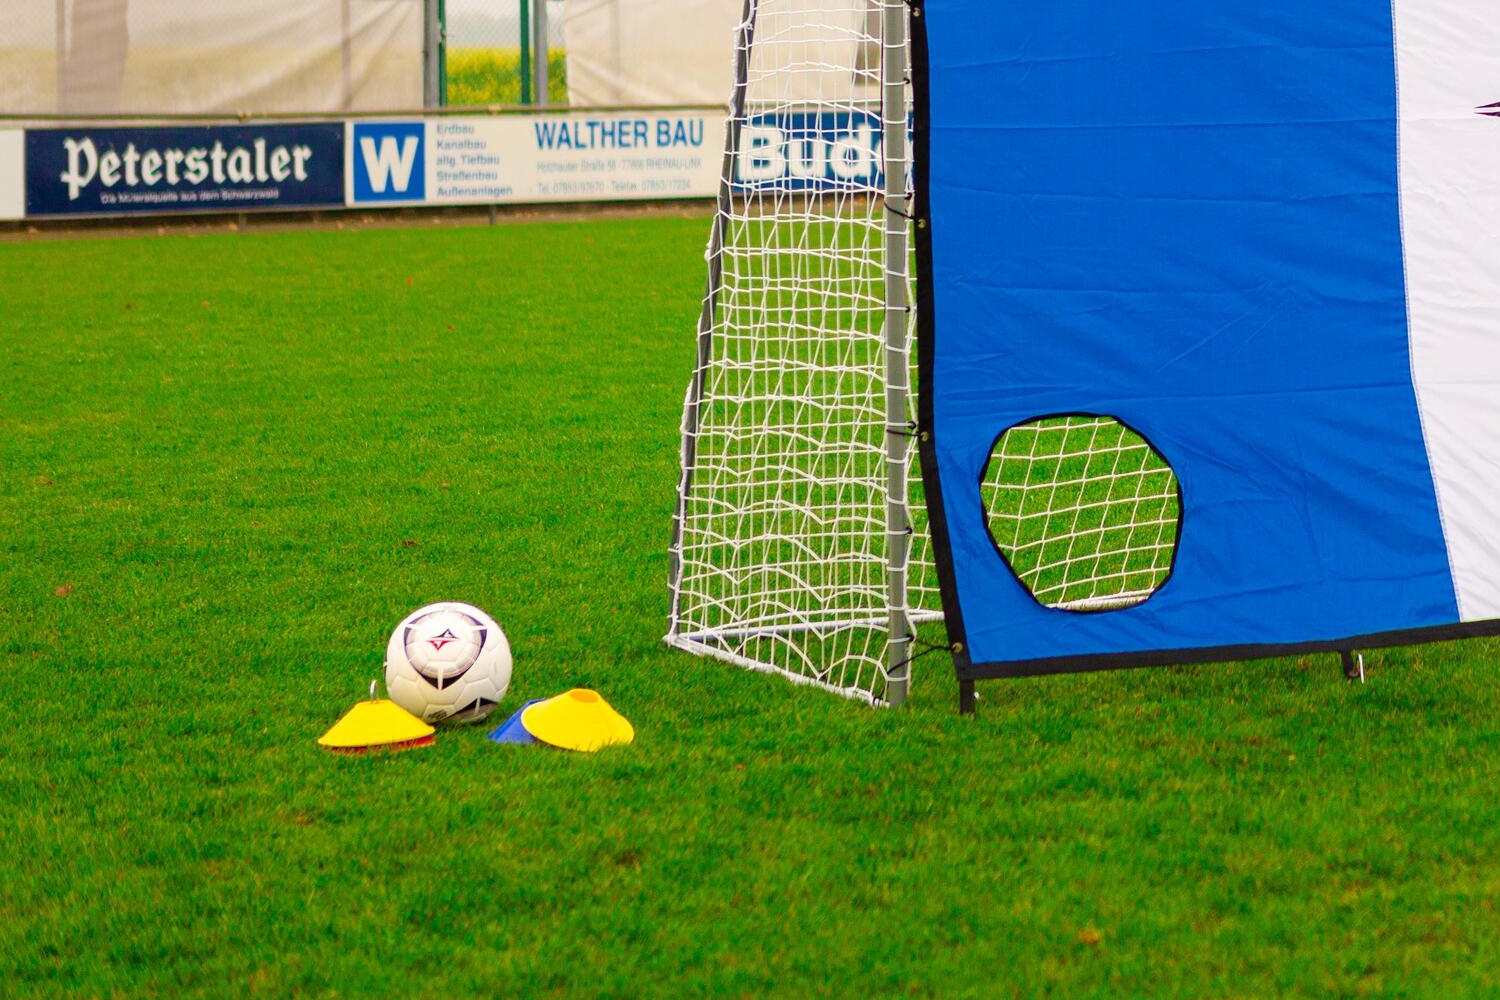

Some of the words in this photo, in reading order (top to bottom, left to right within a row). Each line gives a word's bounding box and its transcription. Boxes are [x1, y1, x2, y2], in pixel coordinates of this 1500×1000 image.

[436, 124, 475, 135] Erdbau
[535, 120, 649, 150] WALTHER
[656, 118, 704, 148] BAU
[436, 139, 486, 151] Kanalbau
[738, 122, 912, 182] Bud
[360, 136, 419, 193] W
[460, 153, 500, 166] Tiefbau
[60, 135, 312, 200] Peterstaler
[436, 170, 497, 182] Straßenbau
[436, 185, 512, 199] Außenanlagen
